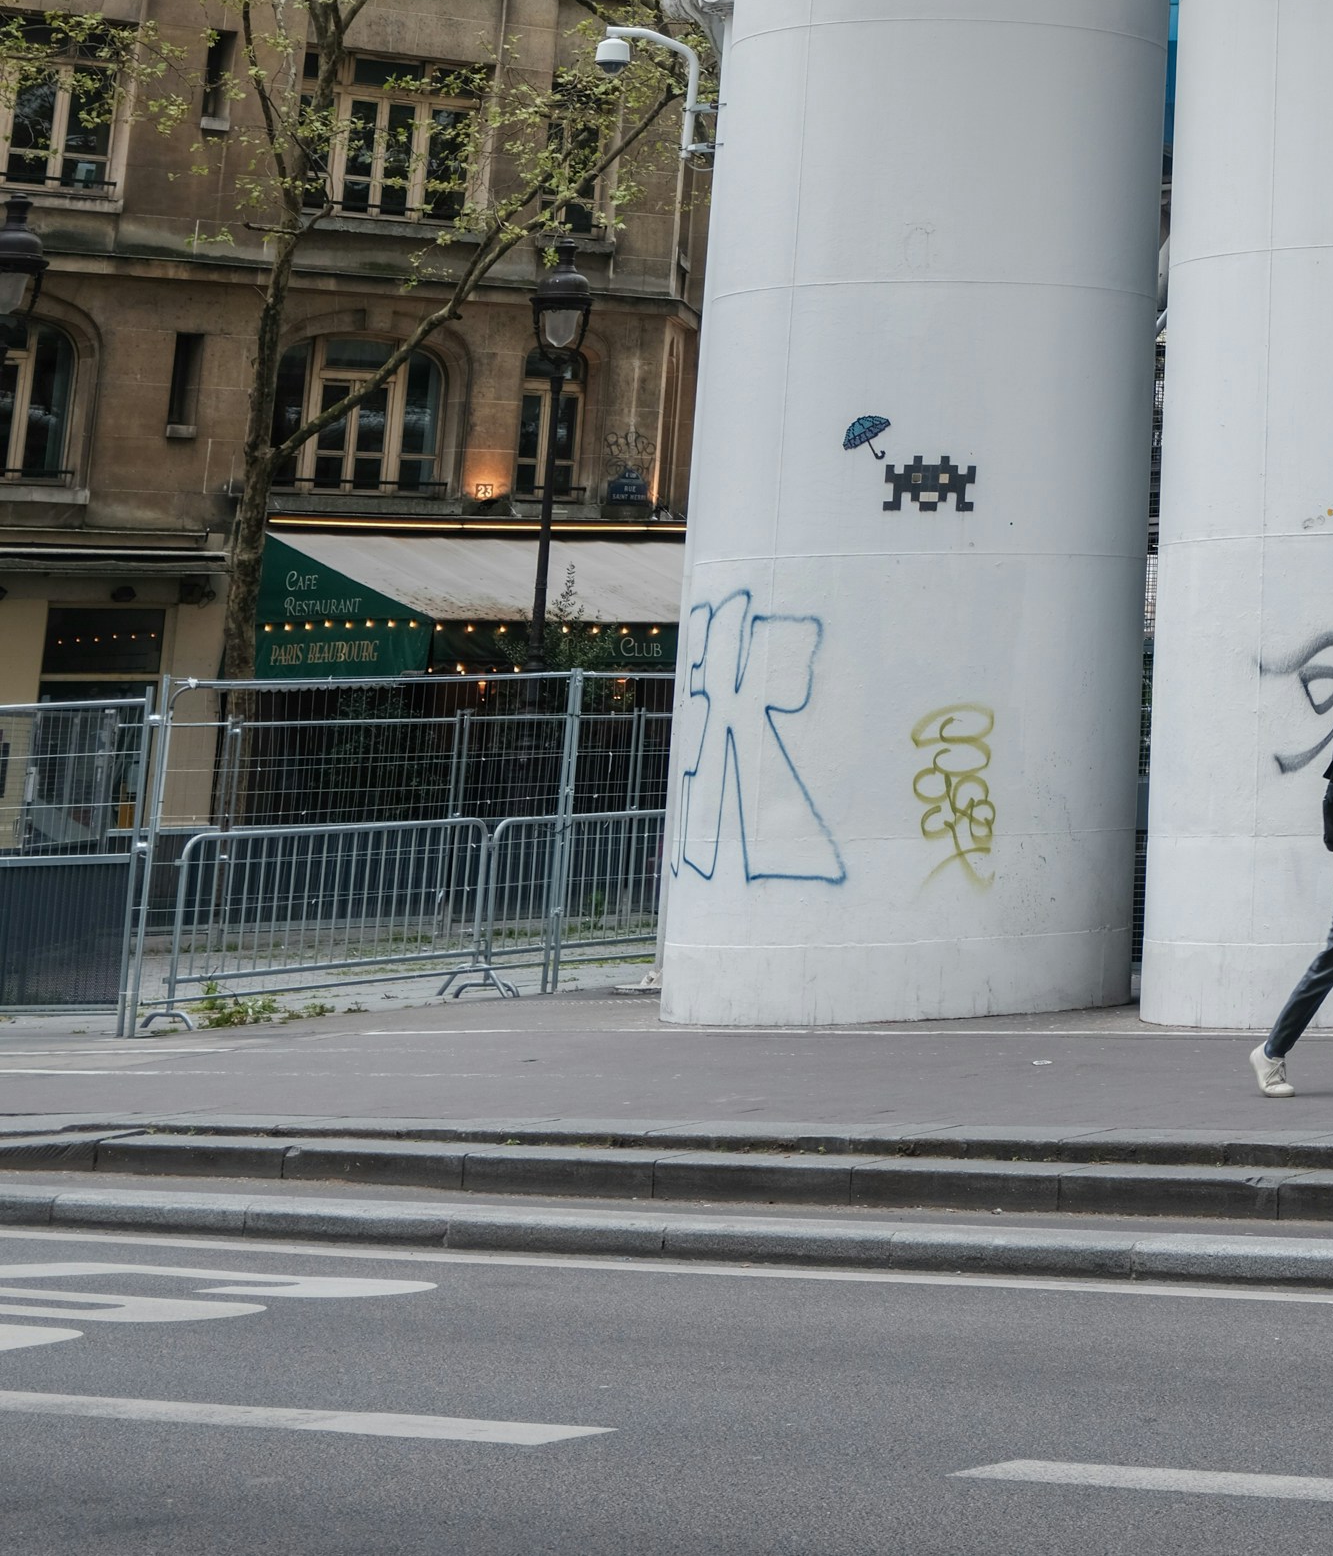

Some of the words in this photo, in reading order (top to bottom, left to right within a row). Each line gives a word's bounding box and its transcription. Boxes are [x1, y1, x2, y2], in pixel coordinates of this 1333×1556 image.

[477, 484, 492, 498] 23
[623, 485, 637, 493] RUE
[284, 596, 362, 617] RESTAURANT
[269, 643, 305, 666] PARIS
[307, 640, 380, 664] BEAUBOURG
[619, 637, 663, 657] CLUB
